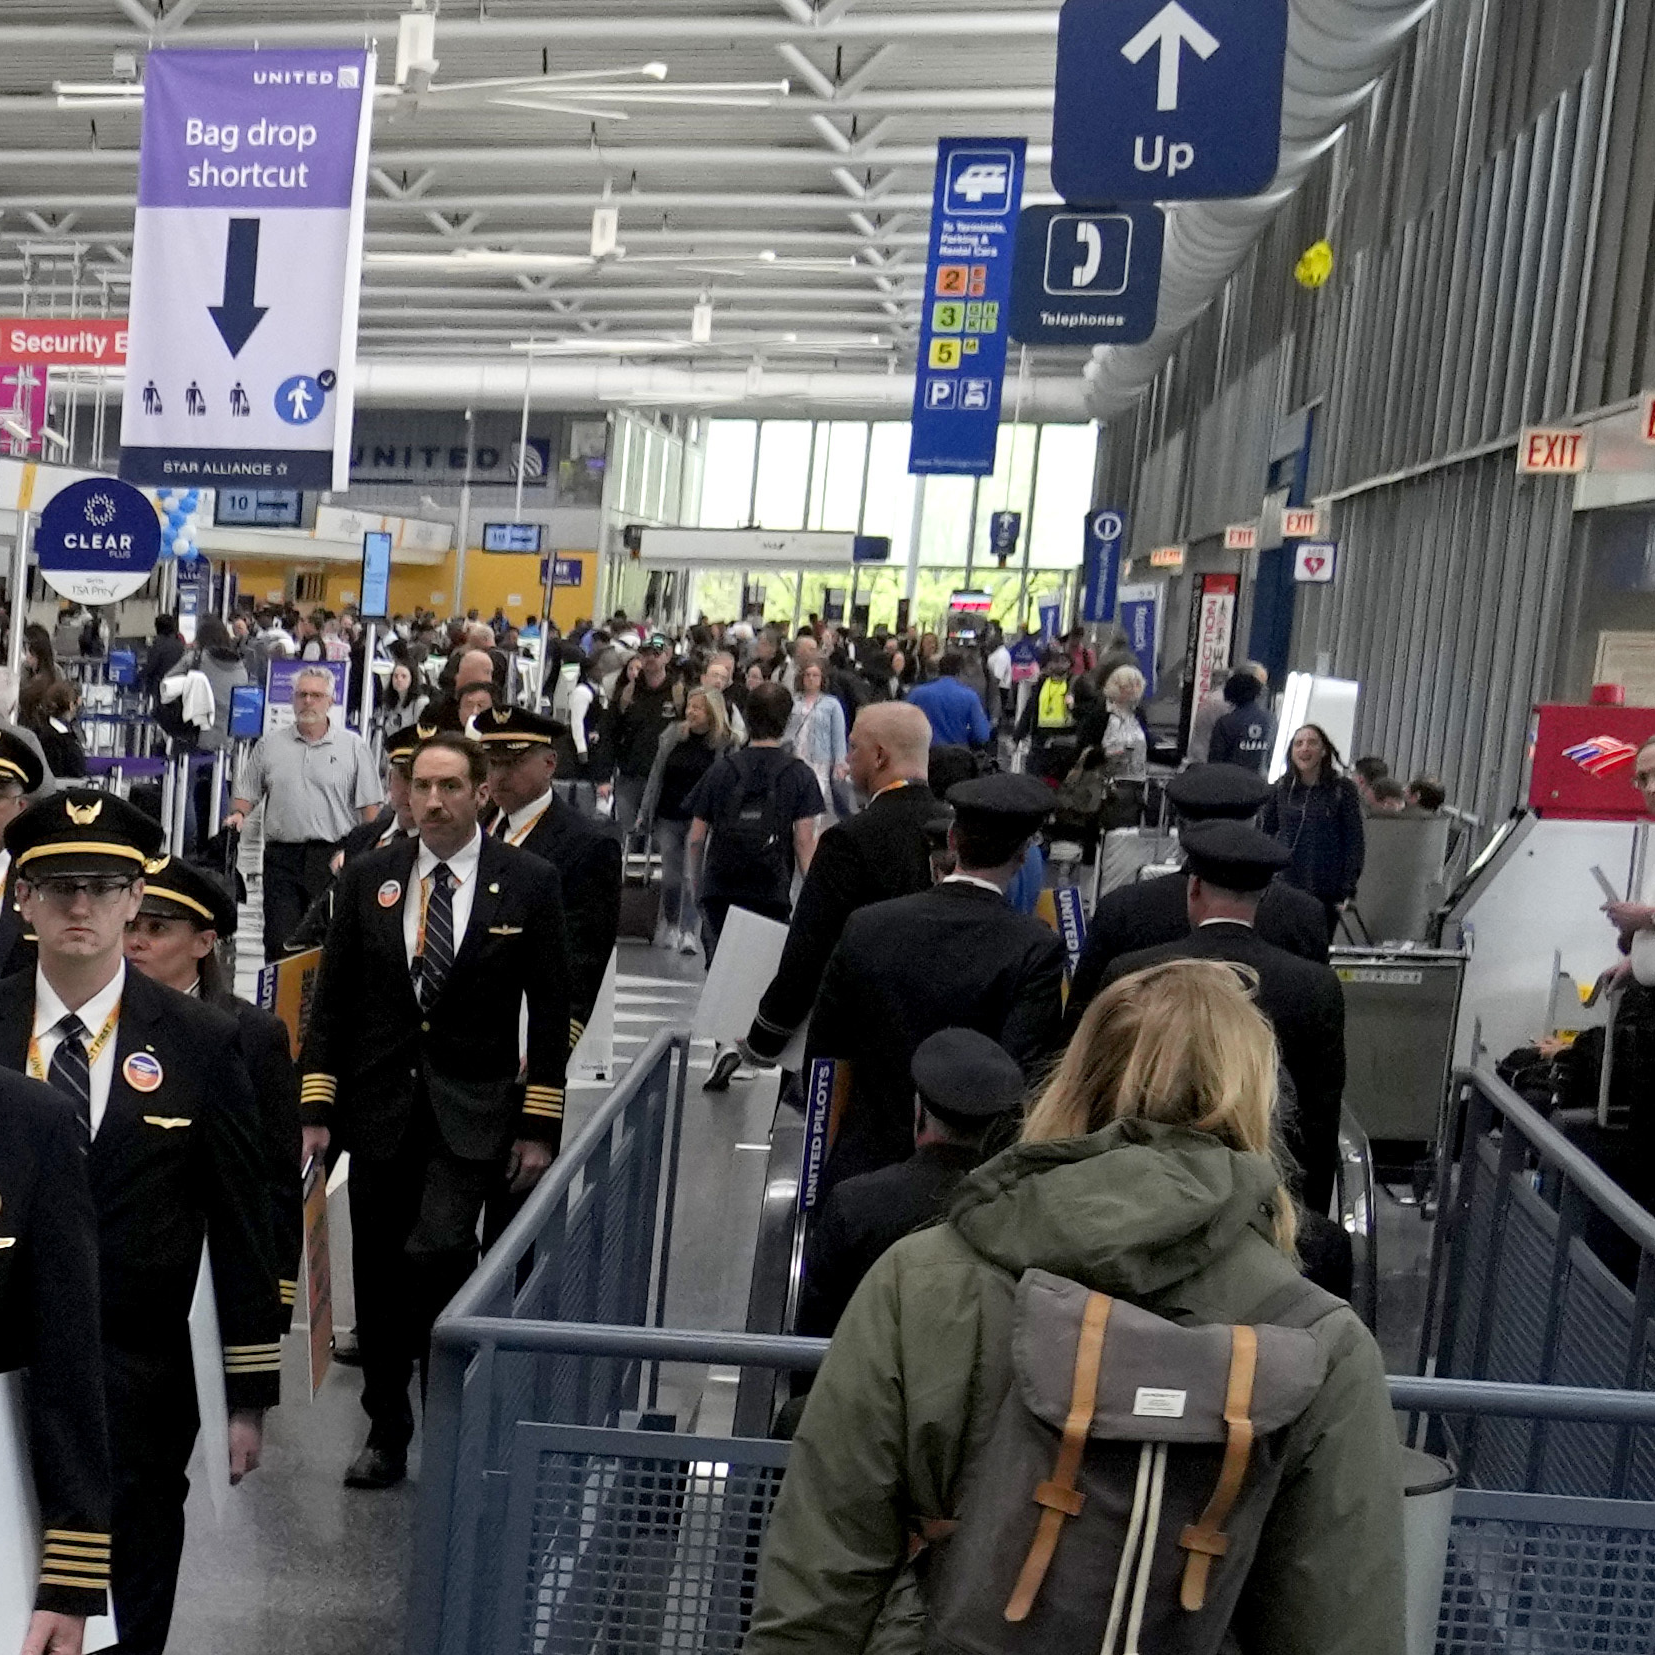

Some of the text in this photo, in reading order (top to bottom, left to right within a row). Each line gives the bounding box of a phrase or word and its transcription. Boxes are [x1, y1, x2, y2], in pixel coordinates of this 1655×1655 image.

[253, 70, 333, 85] UNITED
[185, 117, 317, 153] Bag drop
[1133, 135, 1195, 178] Up
[187, 158, 309, 188] shortcut
[944, 270, 960, 290] 2
[941, 306, 956, 327] 3
[1040, 313, 1125, 328] Telephones
[11, 331, 107, 358] Security
[938, 342, 952, 364] 5
[931, 385, 950, 406] P
[1526, 435, 1582, 468] EXIT
[163, 460, 272, 476] STAR ALLIANCE
[229, 496, 249, 511] 10
[1286, 513, 1314, 533] EXIT
[63, 532, 132, 550] CLEAR
[805, 1065, 831, 1207] UNITED PILOTS
